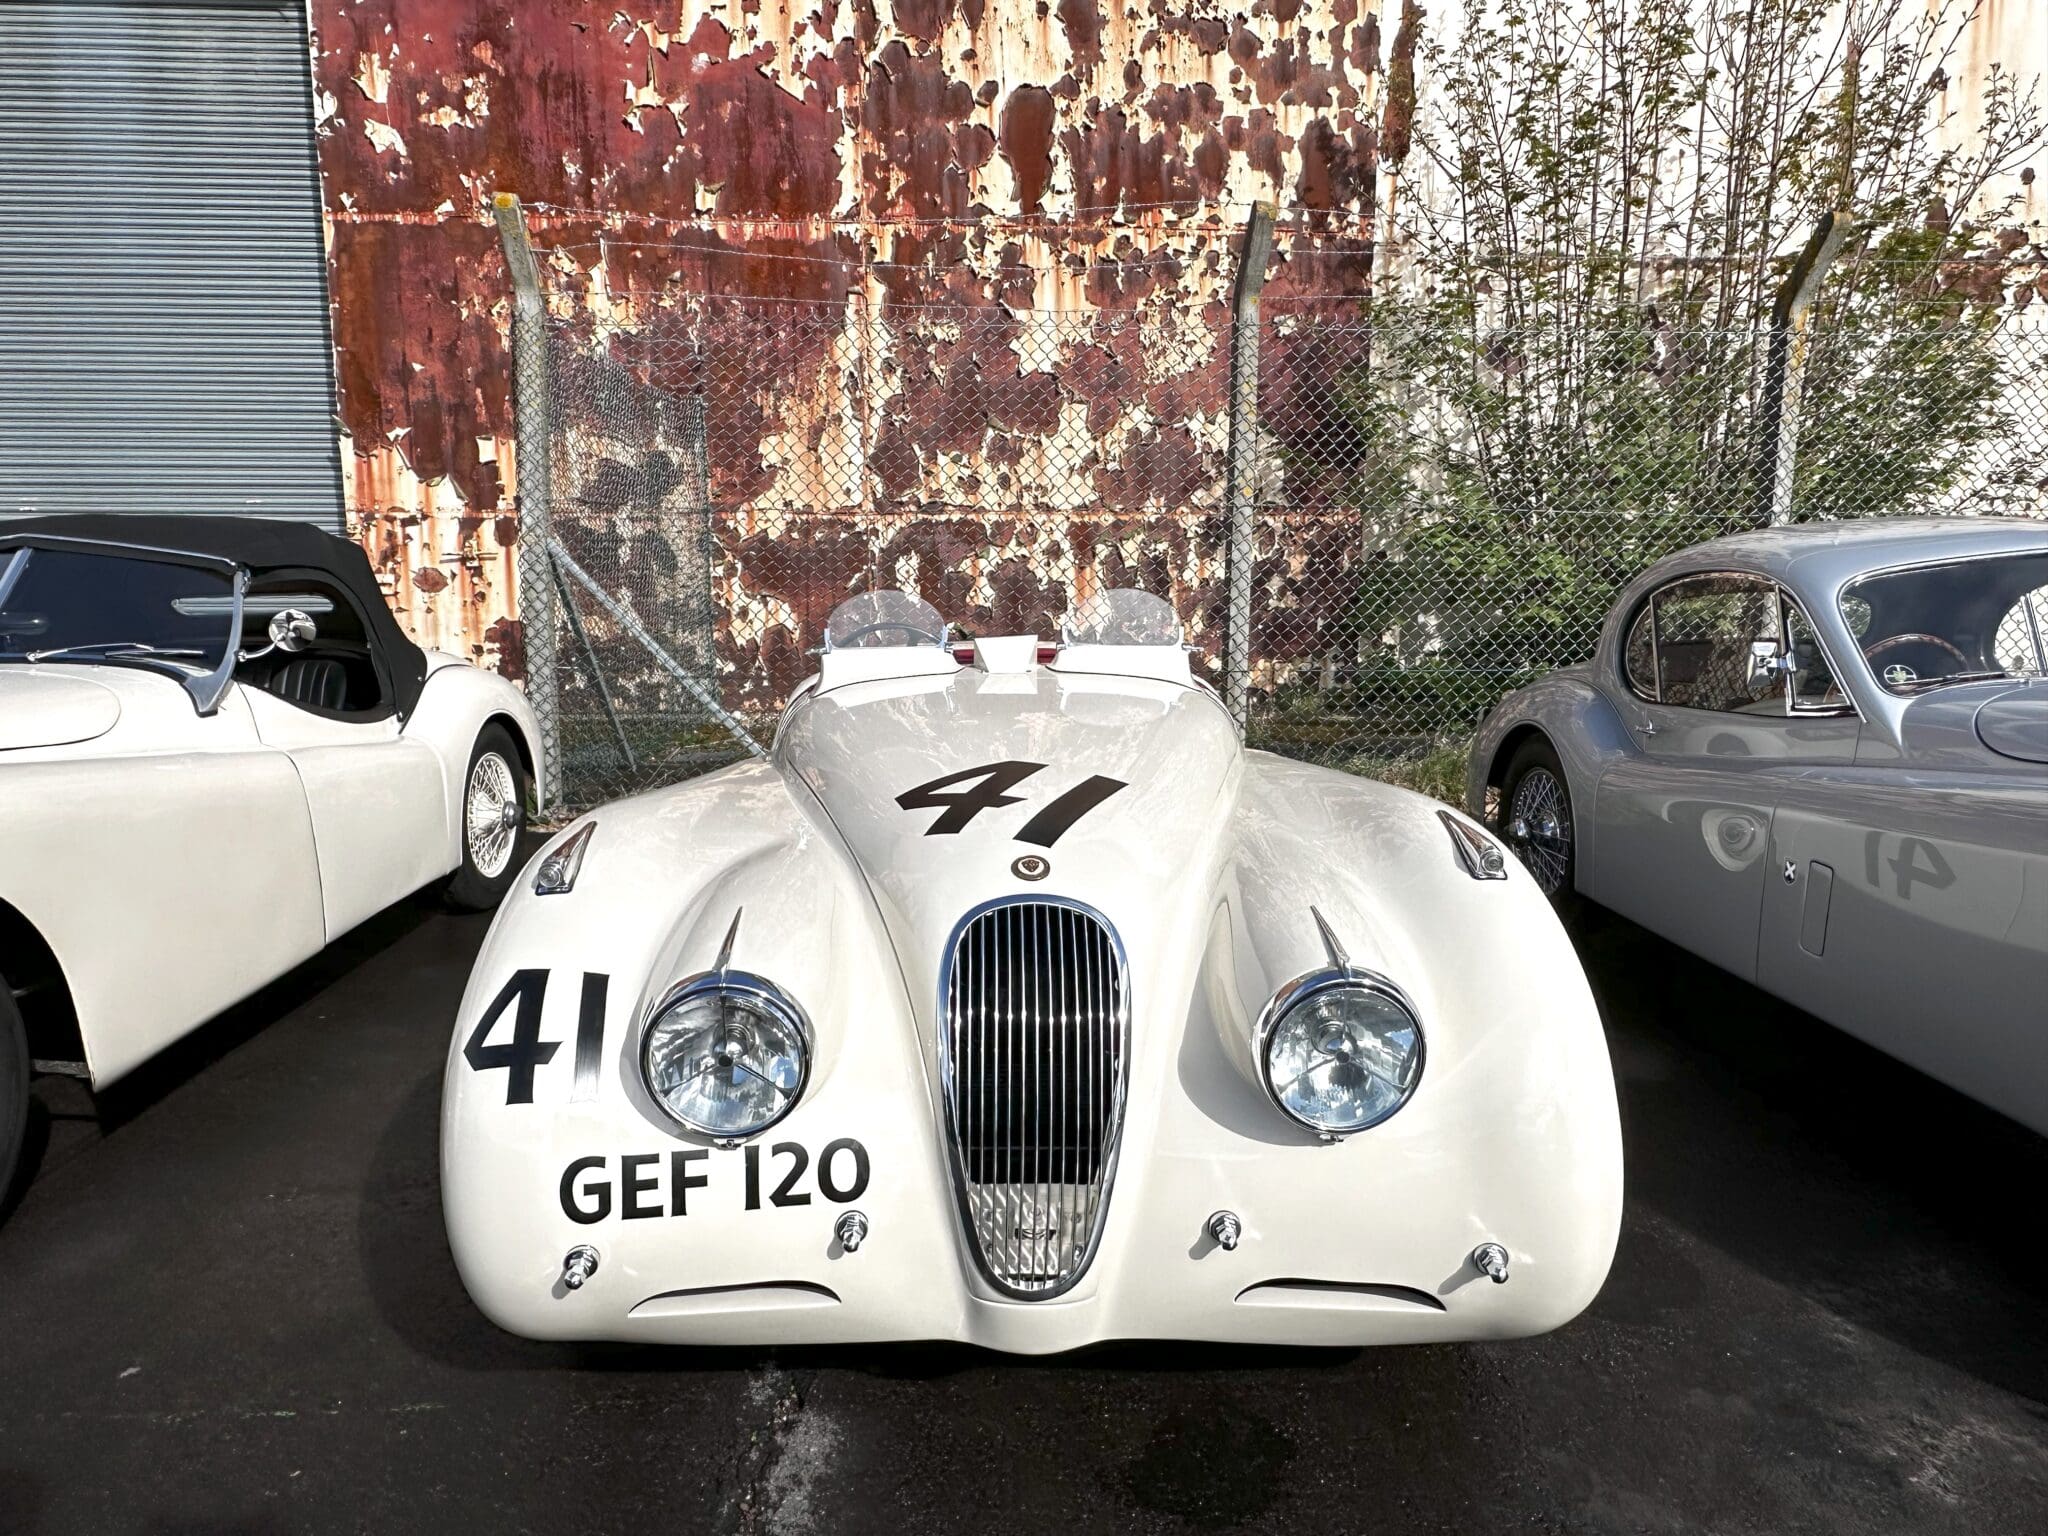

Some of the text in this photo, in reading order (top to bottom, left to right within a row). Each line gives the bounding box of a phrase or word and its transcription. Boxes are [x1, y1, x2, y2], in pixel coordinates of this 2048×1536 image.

[895, 760, 1129, 849] 41
[463, 968, 610, 1105] 41
[559, 1138, 871, 1225] GEF 120
